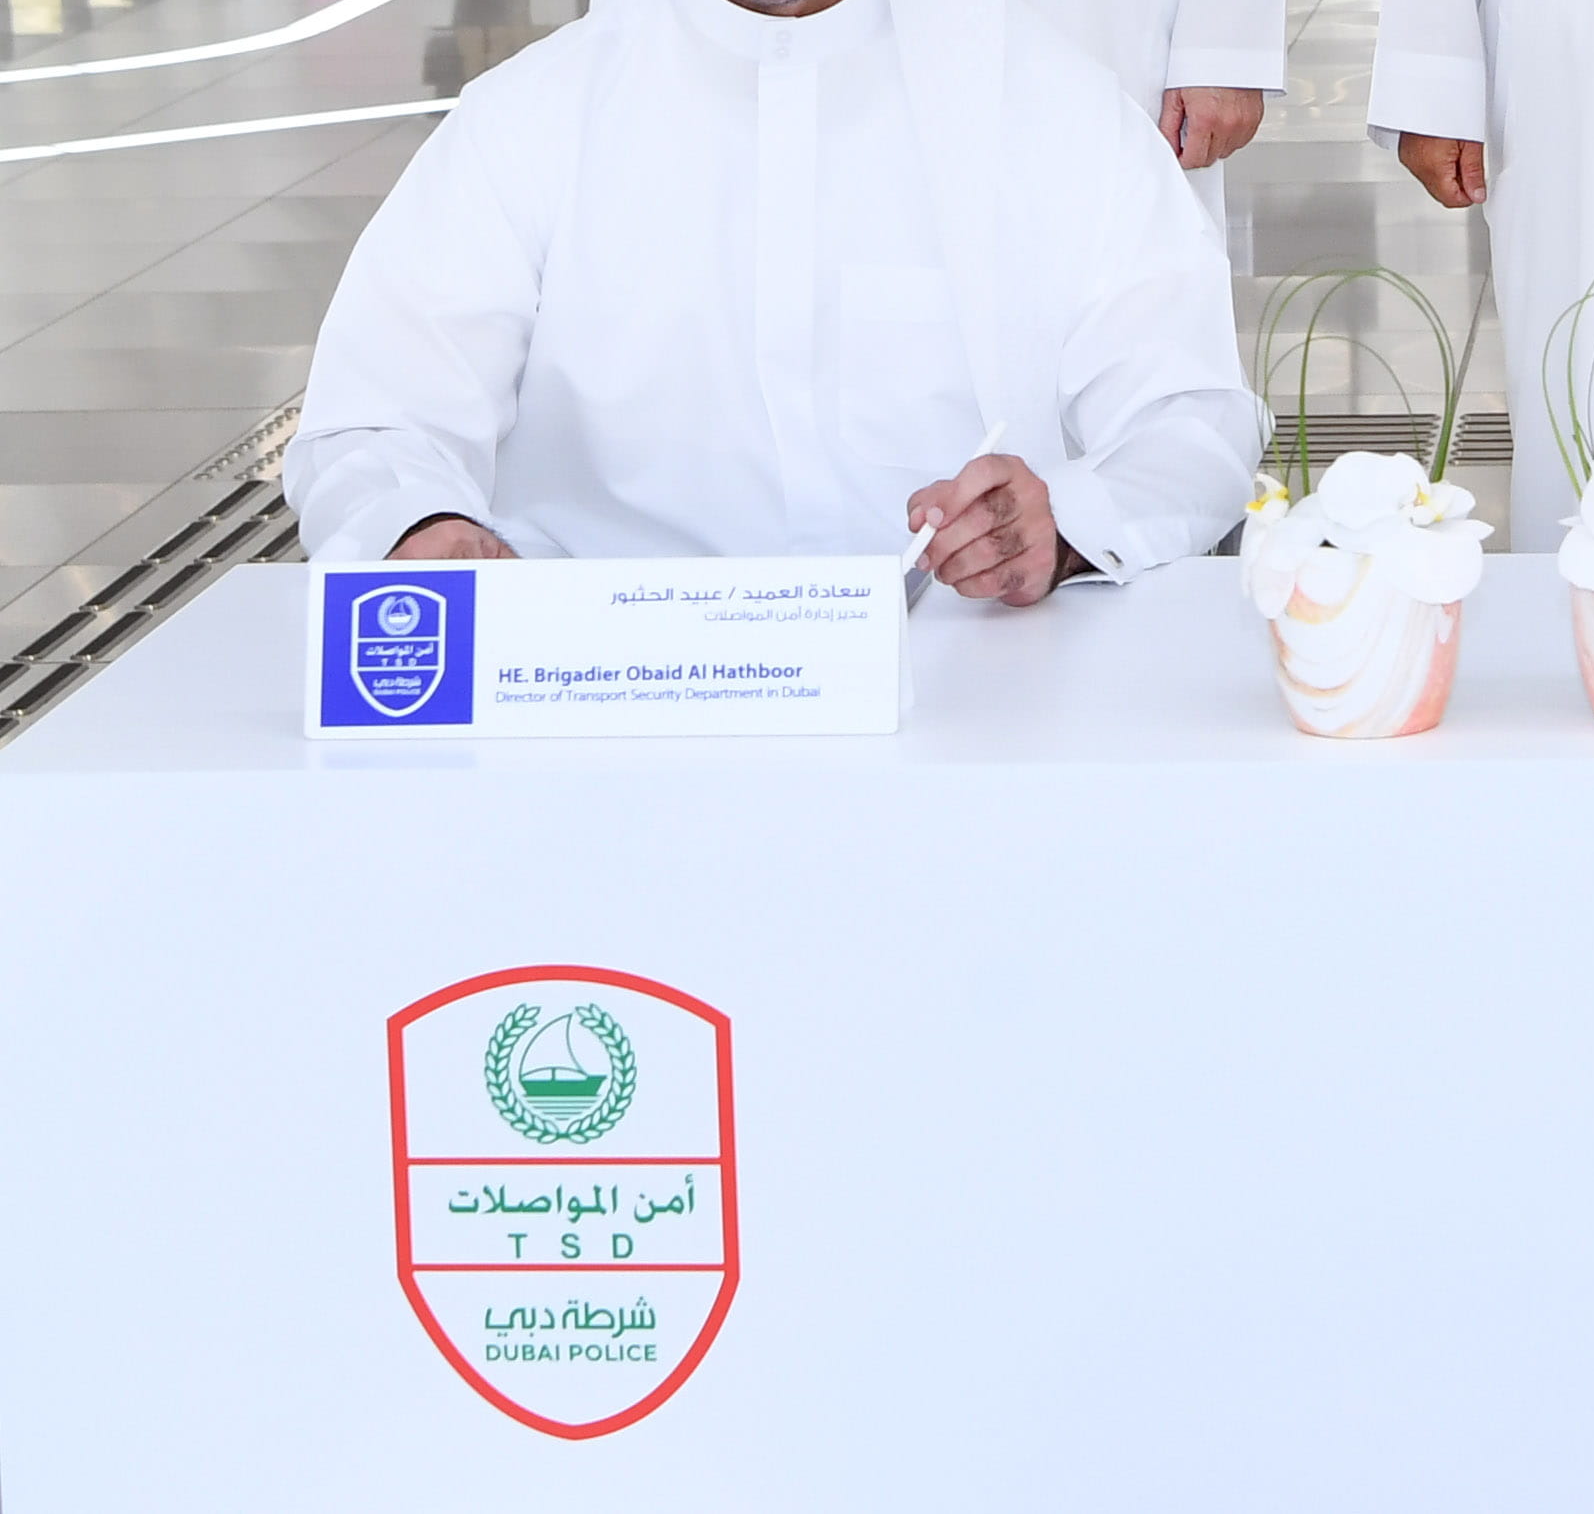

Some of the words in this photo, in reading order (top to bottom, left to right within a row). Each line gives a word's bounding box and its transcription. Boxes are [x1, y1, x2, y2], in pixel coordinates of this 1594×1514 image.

[742, 585, 803, 604] العميد
[808, 584, 871, 599] سعادة
[499, 668, 529, 683] HE.
[534, 666, 621, 686] Brigadier
[626, 664, 682, 681] Obaid
[688, 664, 707, 680] Al
[712, 663, 803, 680] Hathboor
[496, 690, 546, 703] Director
[550, 689, 563, 702] of
[566, 689, 627, 704] Transport
[631, 687, 682, 703] Security
[685, 687, 764, 703] Department
[767, 686, 779, 699] in
[782, 685, 821, 699] Dubai
[448, 1184, 618, 1224] المواصلات
[634, 1173, 695, 1223] أمن
[485, 1307, 555, 1338] دبي
[562, 1296, 656, 1338] شرطة
[485, 1344, 560, 1362] DUBAI
[569, 1344, 657, 1362] POLICE
